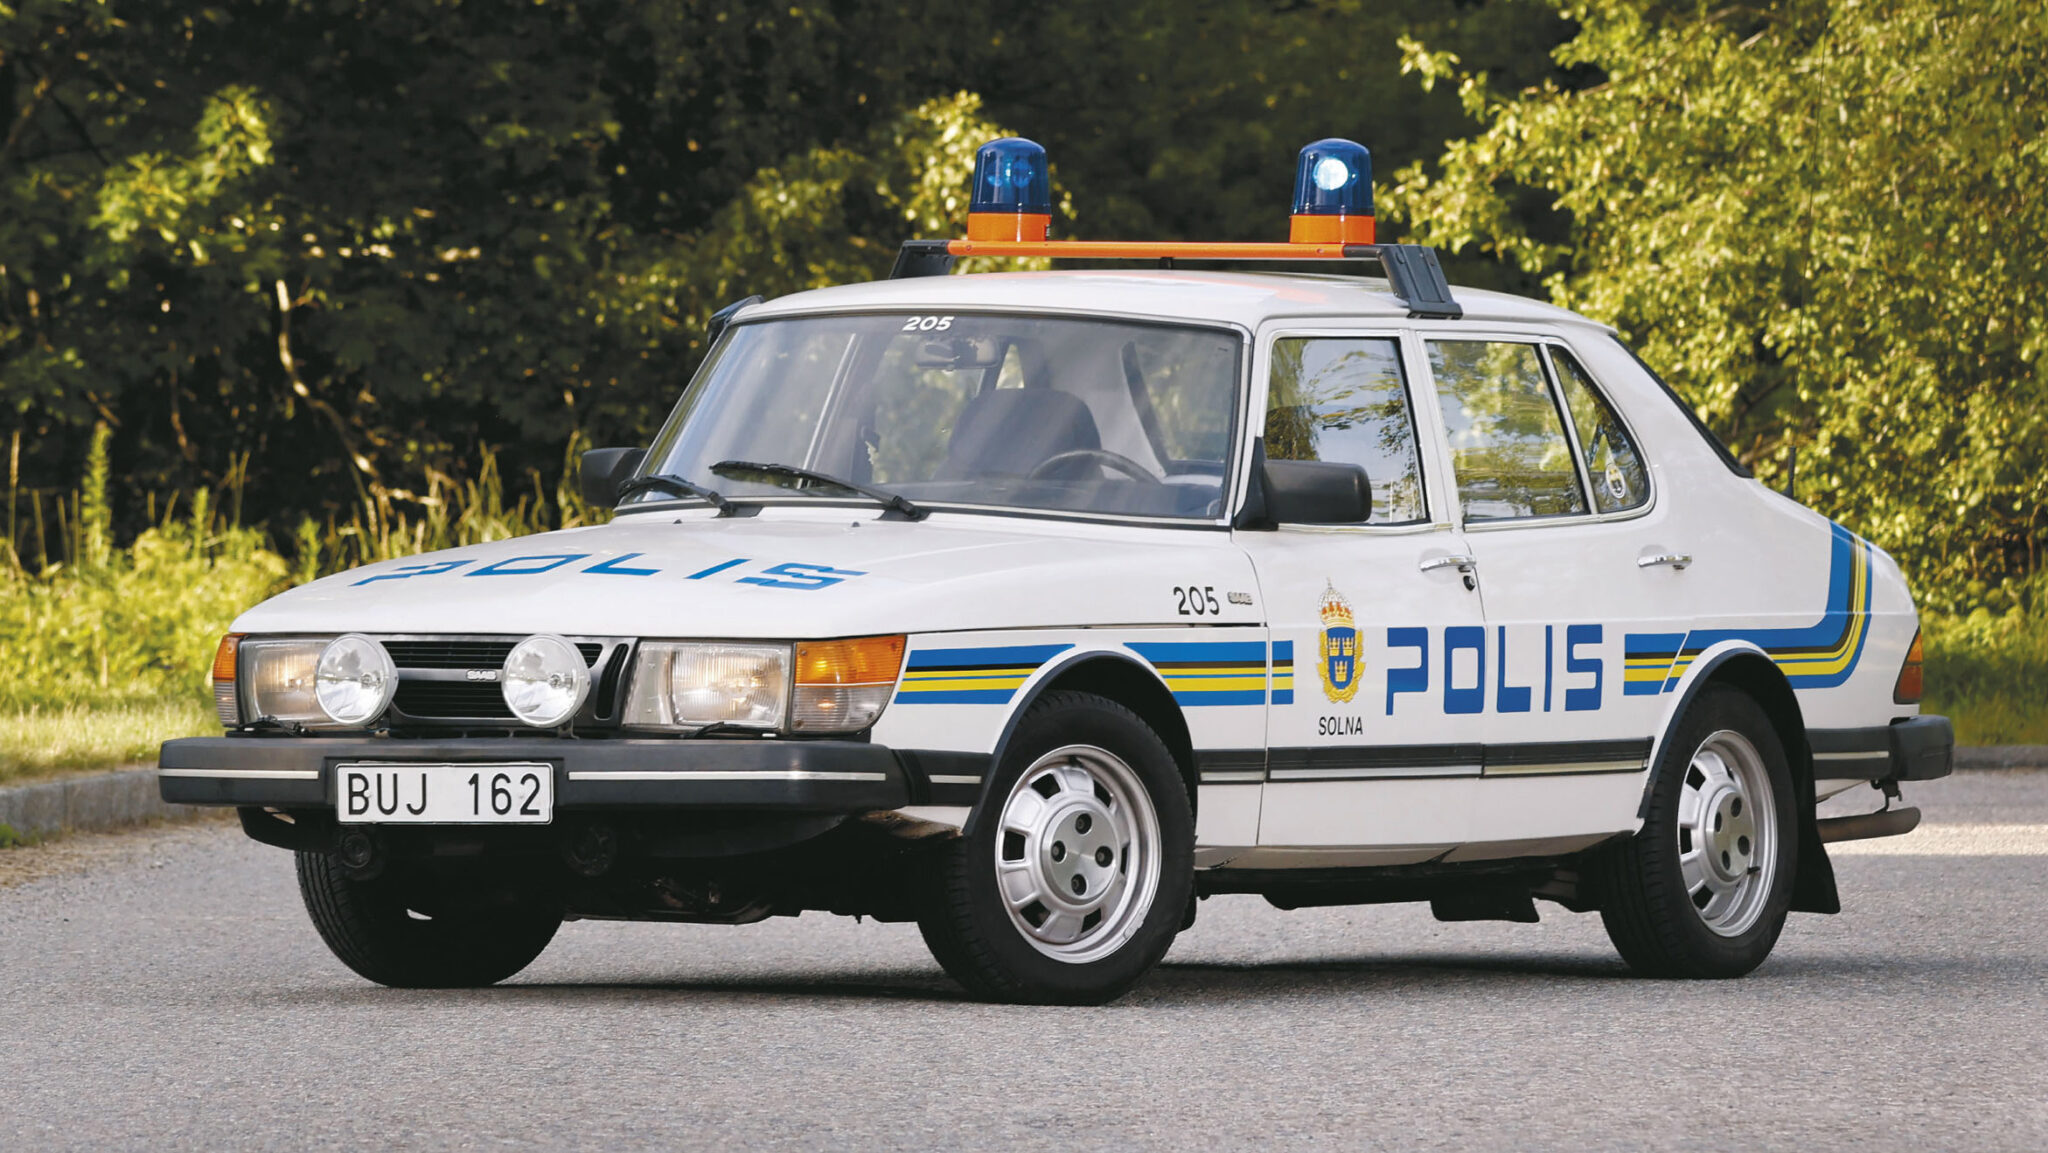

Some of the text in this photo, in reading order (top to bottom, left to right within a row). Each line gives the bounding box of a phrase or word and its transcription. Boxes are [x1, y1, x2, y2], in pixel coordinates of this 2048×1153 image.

[902, 315, 955, 331] 205
[348, 552, 870, 591] POLIS
[1173, 585, 1220, 616] 205
[1385, 623, 1603, 716] POLIS
[1318, 716, 1363, 736] SOLNA
[347, 773, 541, 815] BUJ 162
